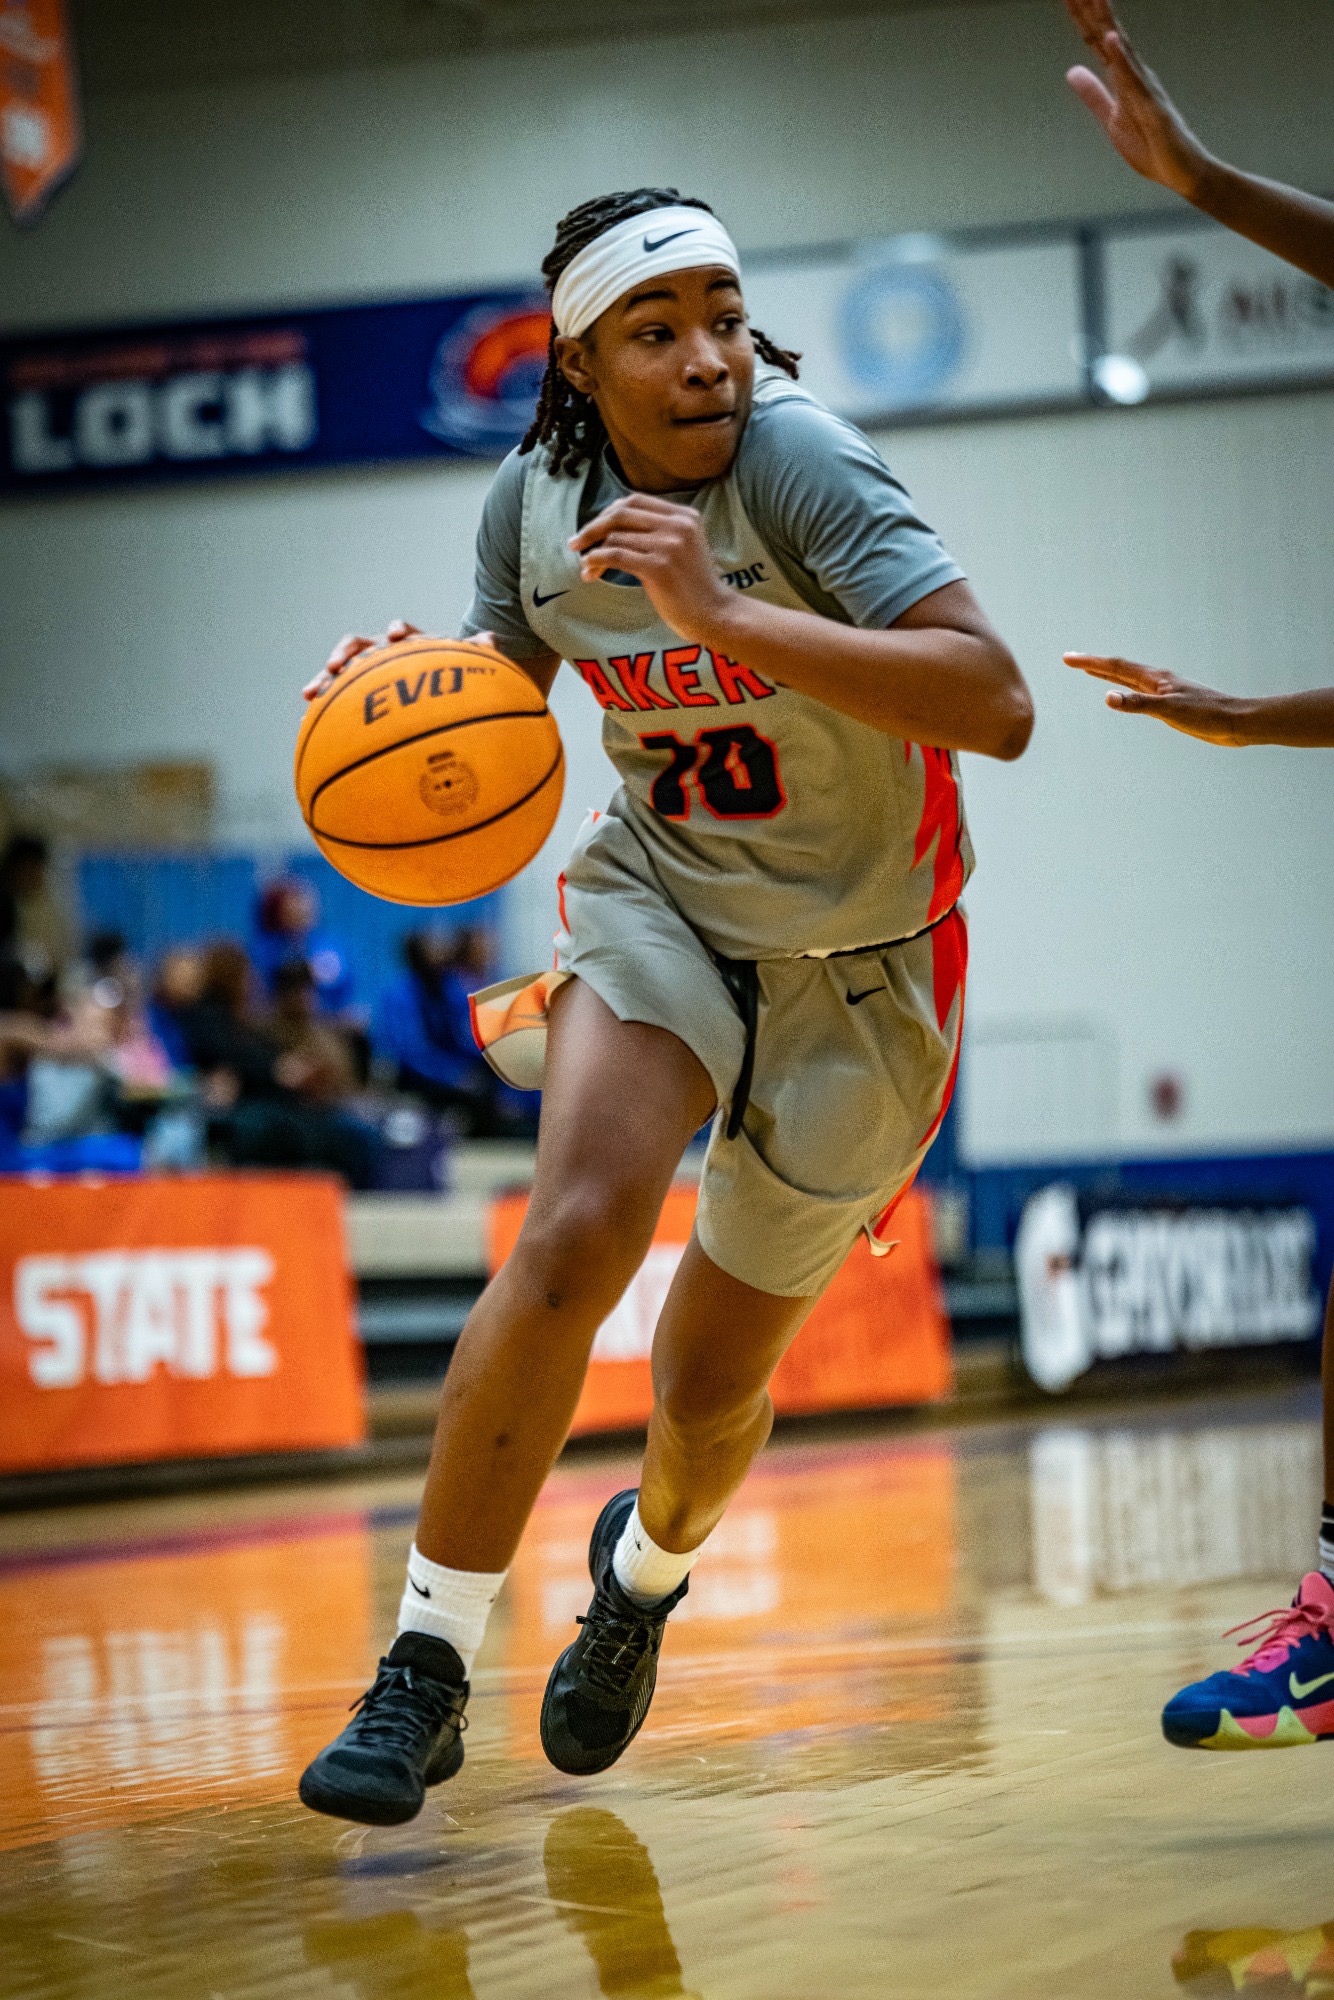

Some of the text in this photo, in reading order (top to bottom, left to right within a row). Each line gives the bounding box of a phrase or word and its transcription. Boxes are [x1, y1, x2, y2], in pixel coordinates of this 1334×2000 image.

[363, 665, 463, 726] EVO
[573, 644, 789, 712] AKER
[14, 1245, 278, 1390] STATE
